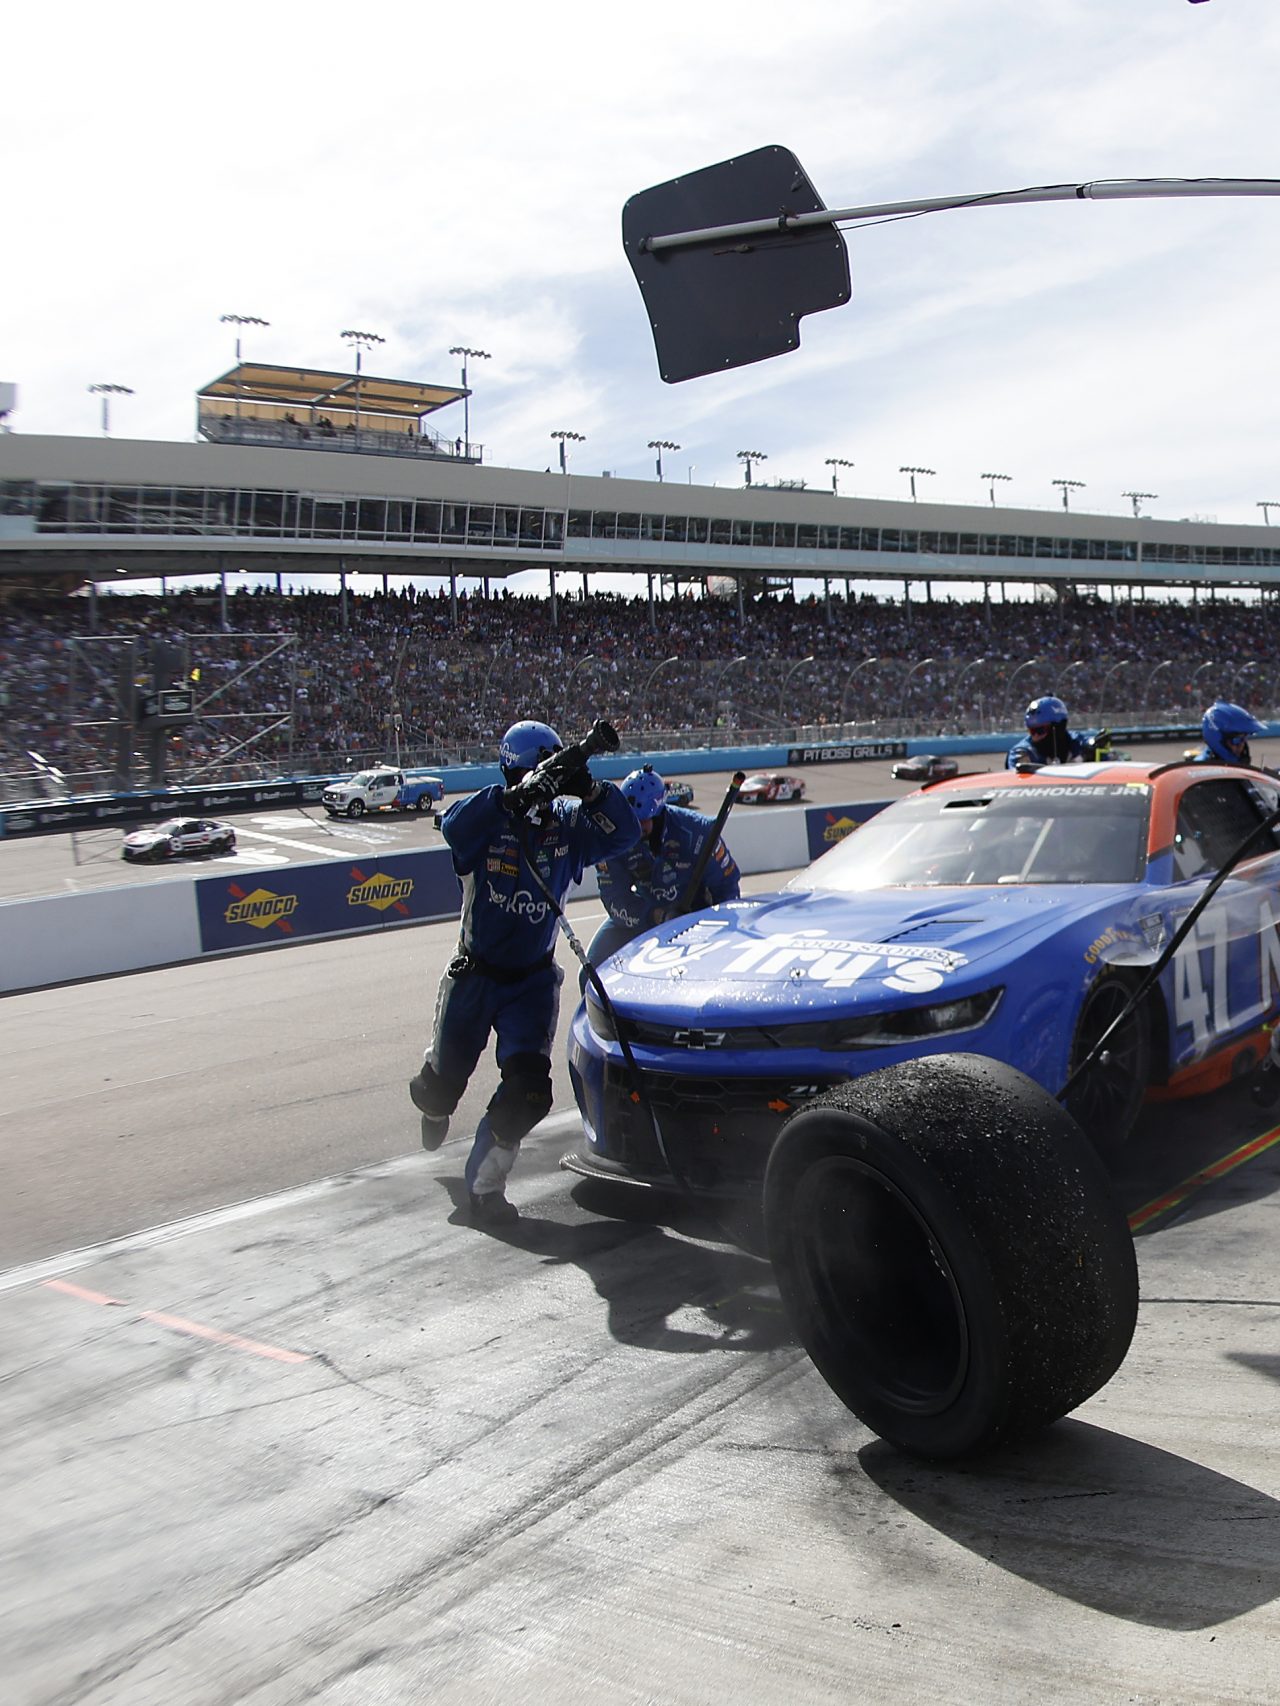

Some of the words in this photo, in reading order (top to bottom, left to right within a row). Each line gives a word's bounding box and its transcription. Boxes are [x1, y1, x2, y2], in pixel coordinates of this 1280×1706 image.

[804, 749, 821, 761] PIT
[821, 747, 851, 761] BOSS
[853, 745, 893, 759] GRILLS
[394, 775, 400, 786] 2
[984, 786, 1106, 799] STENHOUSE
[1110, 785, 1140, 797] JR
[171, 837, 182, 851] 8
[350, 880, 412, 903] SUNOCO
[229, 897, 295, 921] SUNOCO
[505, 890, 551, 924] Krog
[790, 940, 850, 951] FOOD
[856, 942, 951, 962] STORES
